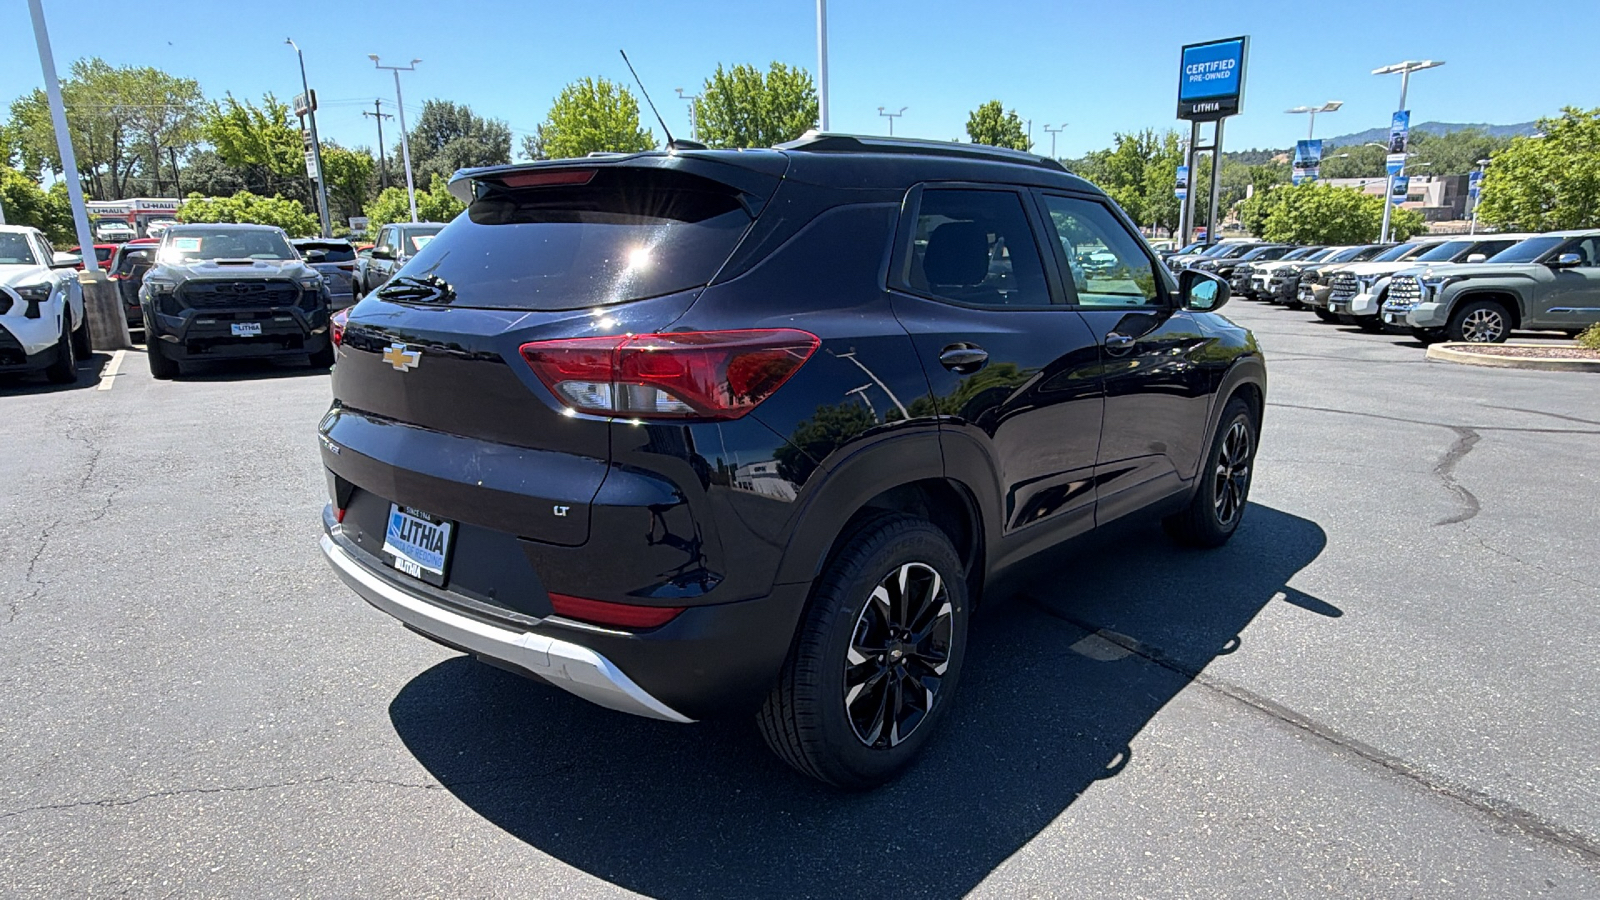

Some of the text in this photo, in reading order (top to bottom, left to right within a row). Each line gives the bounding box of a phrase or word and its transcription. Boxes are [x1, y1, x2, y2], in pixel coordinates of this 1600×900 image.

[1186, 58, 1235, 75] CERTIFIED
[1189, 71, 1231, 83] PRE-OWNED
[1192, 102, 1220, 113] LITHIA
[406, 506, 419, 517] SINCE
[553, 505, 570, 517] LT
[400, 517, 444, 556] LITHIA
[406, 544, 414, 556] OF
[415, 548, 443, 568] REDDING
